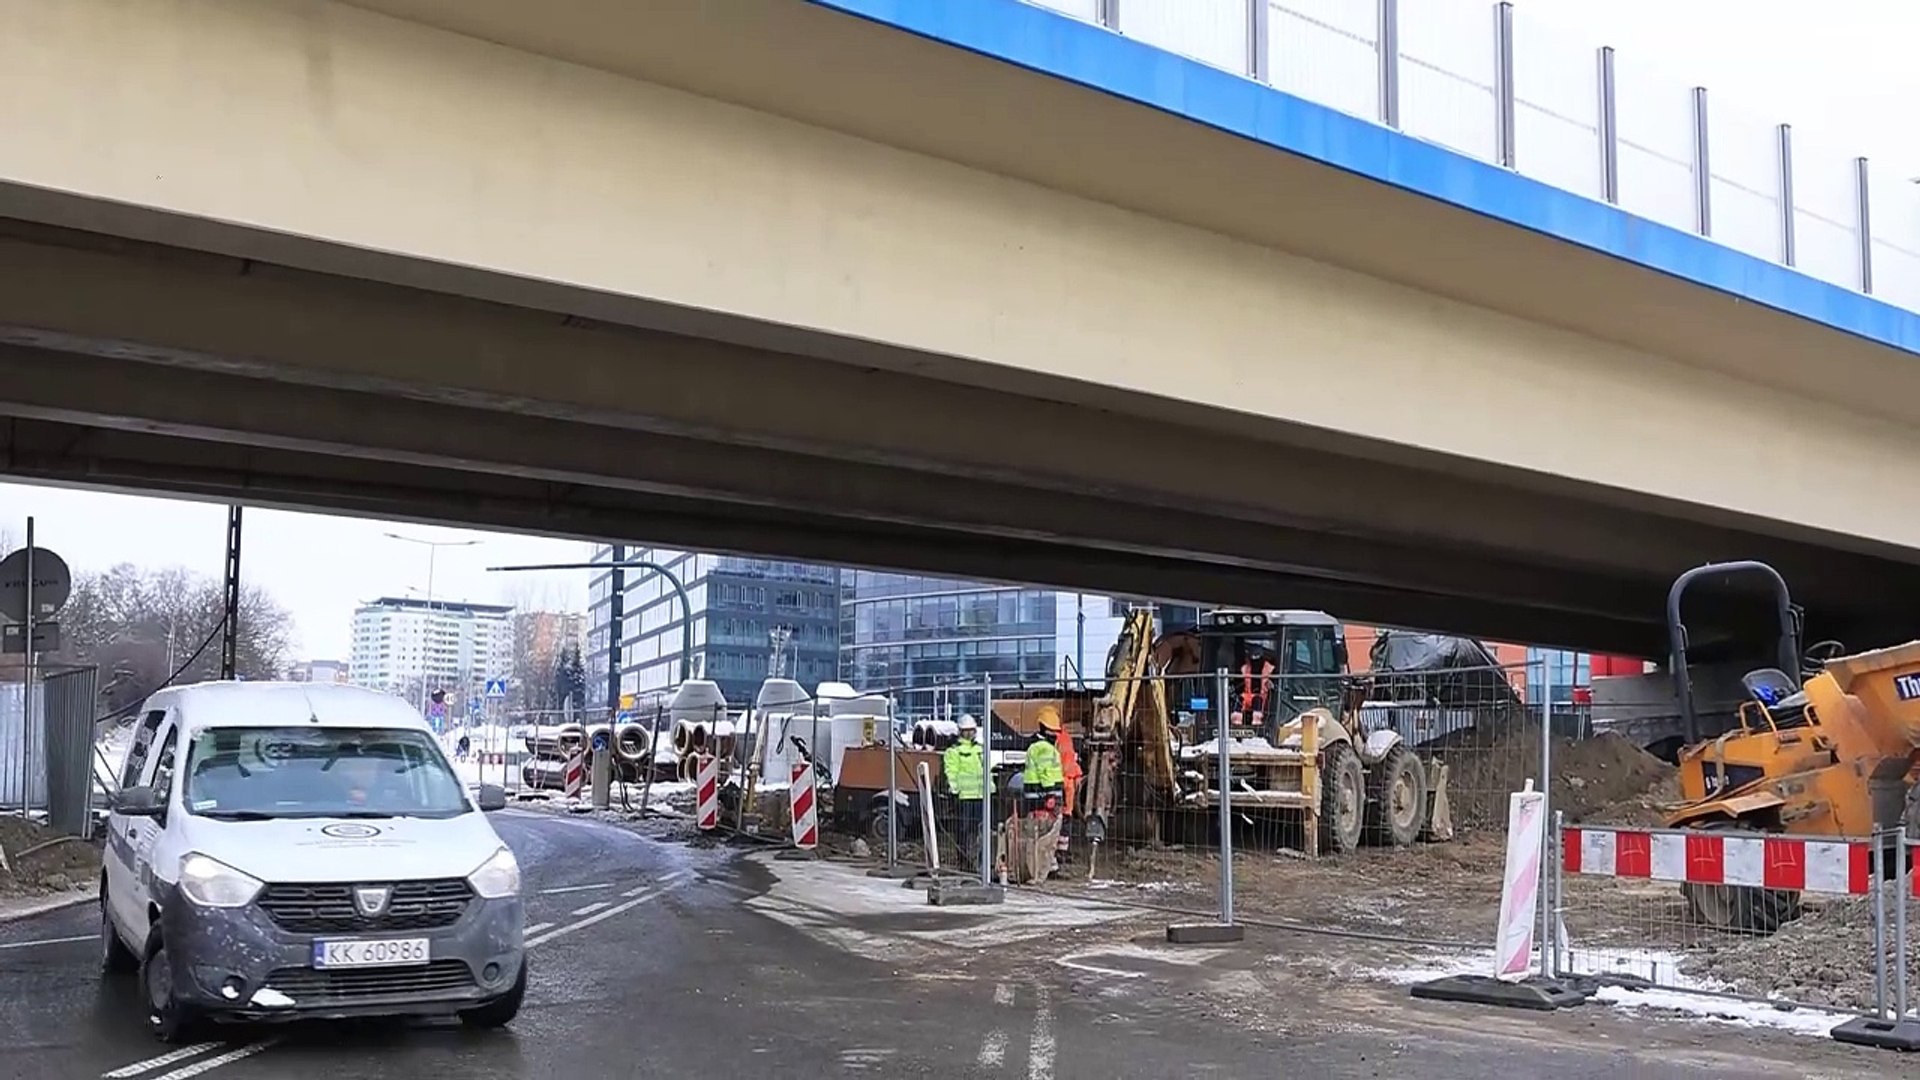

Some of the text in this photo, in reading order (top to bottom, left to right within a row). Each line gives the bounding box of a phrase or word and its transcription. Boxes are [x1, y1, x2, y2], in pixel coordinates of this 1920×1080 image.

[1897, 675, 1920, 698] Th
[328, 941, 424, 962] KK 60986
